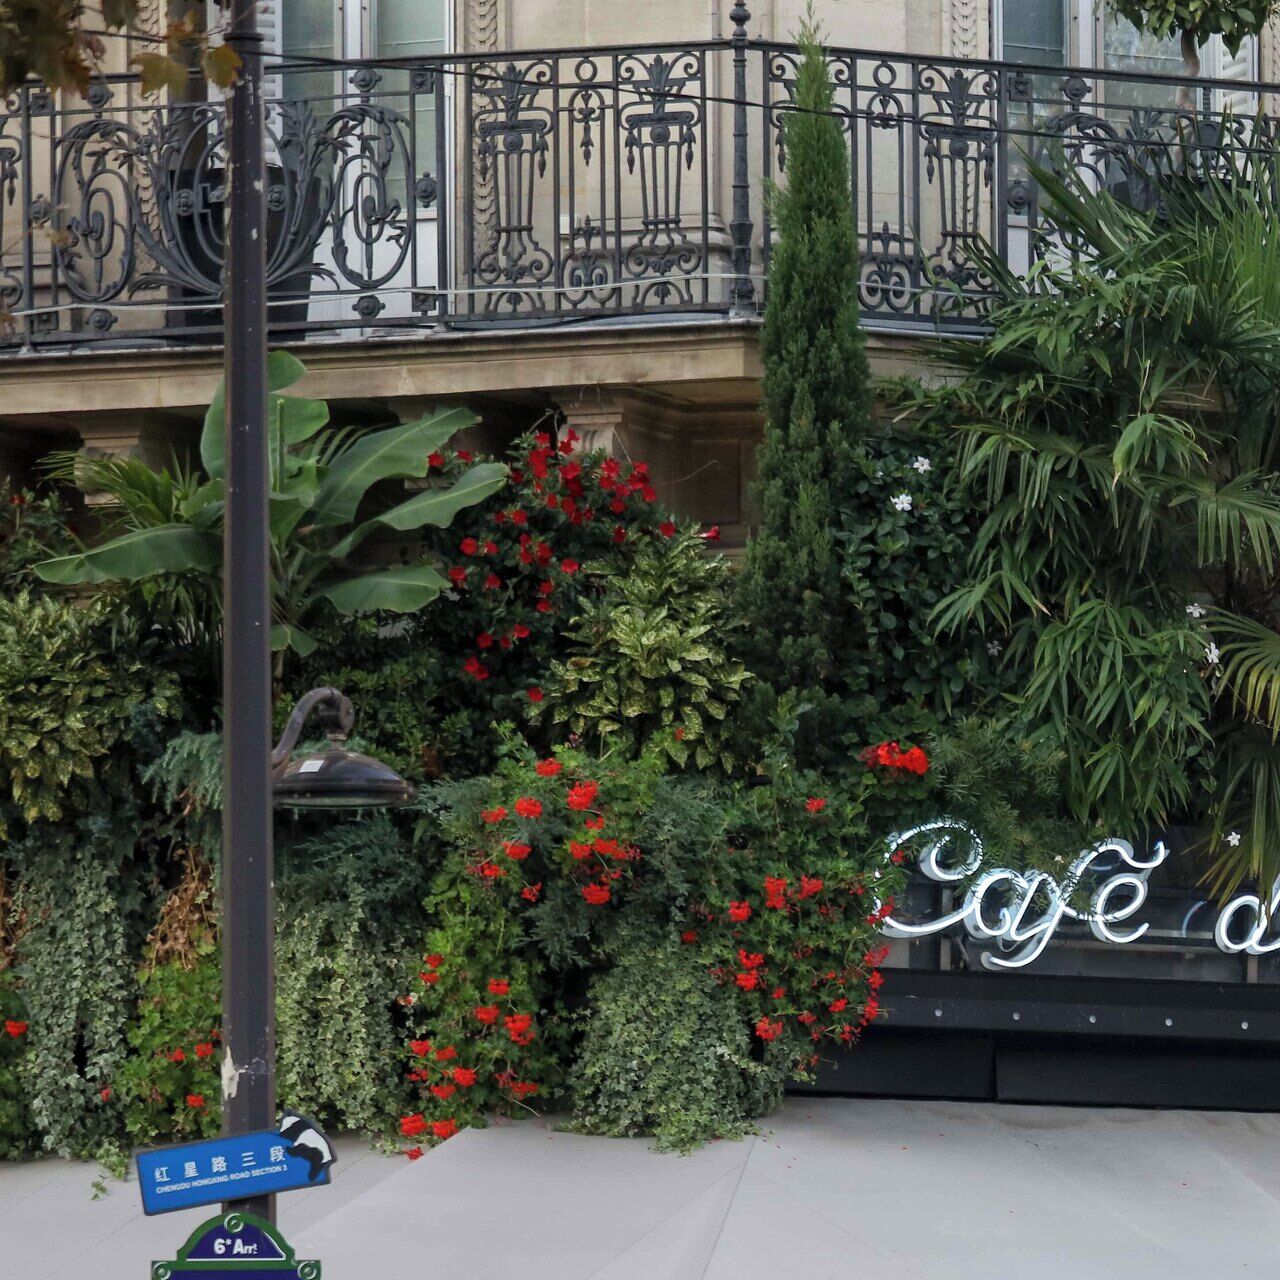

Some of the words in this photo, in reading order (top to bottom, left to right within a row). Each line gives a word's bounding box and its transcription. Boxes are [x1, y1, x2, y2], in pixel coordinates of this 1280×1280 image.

[154, 1145, 287, 1183] 红星路三段
[155, 1182, 192, 1195] CHENGDU
[229, 1171, 251, 1181] ROAD
[251, 1165, 283, 1178] SECTION
